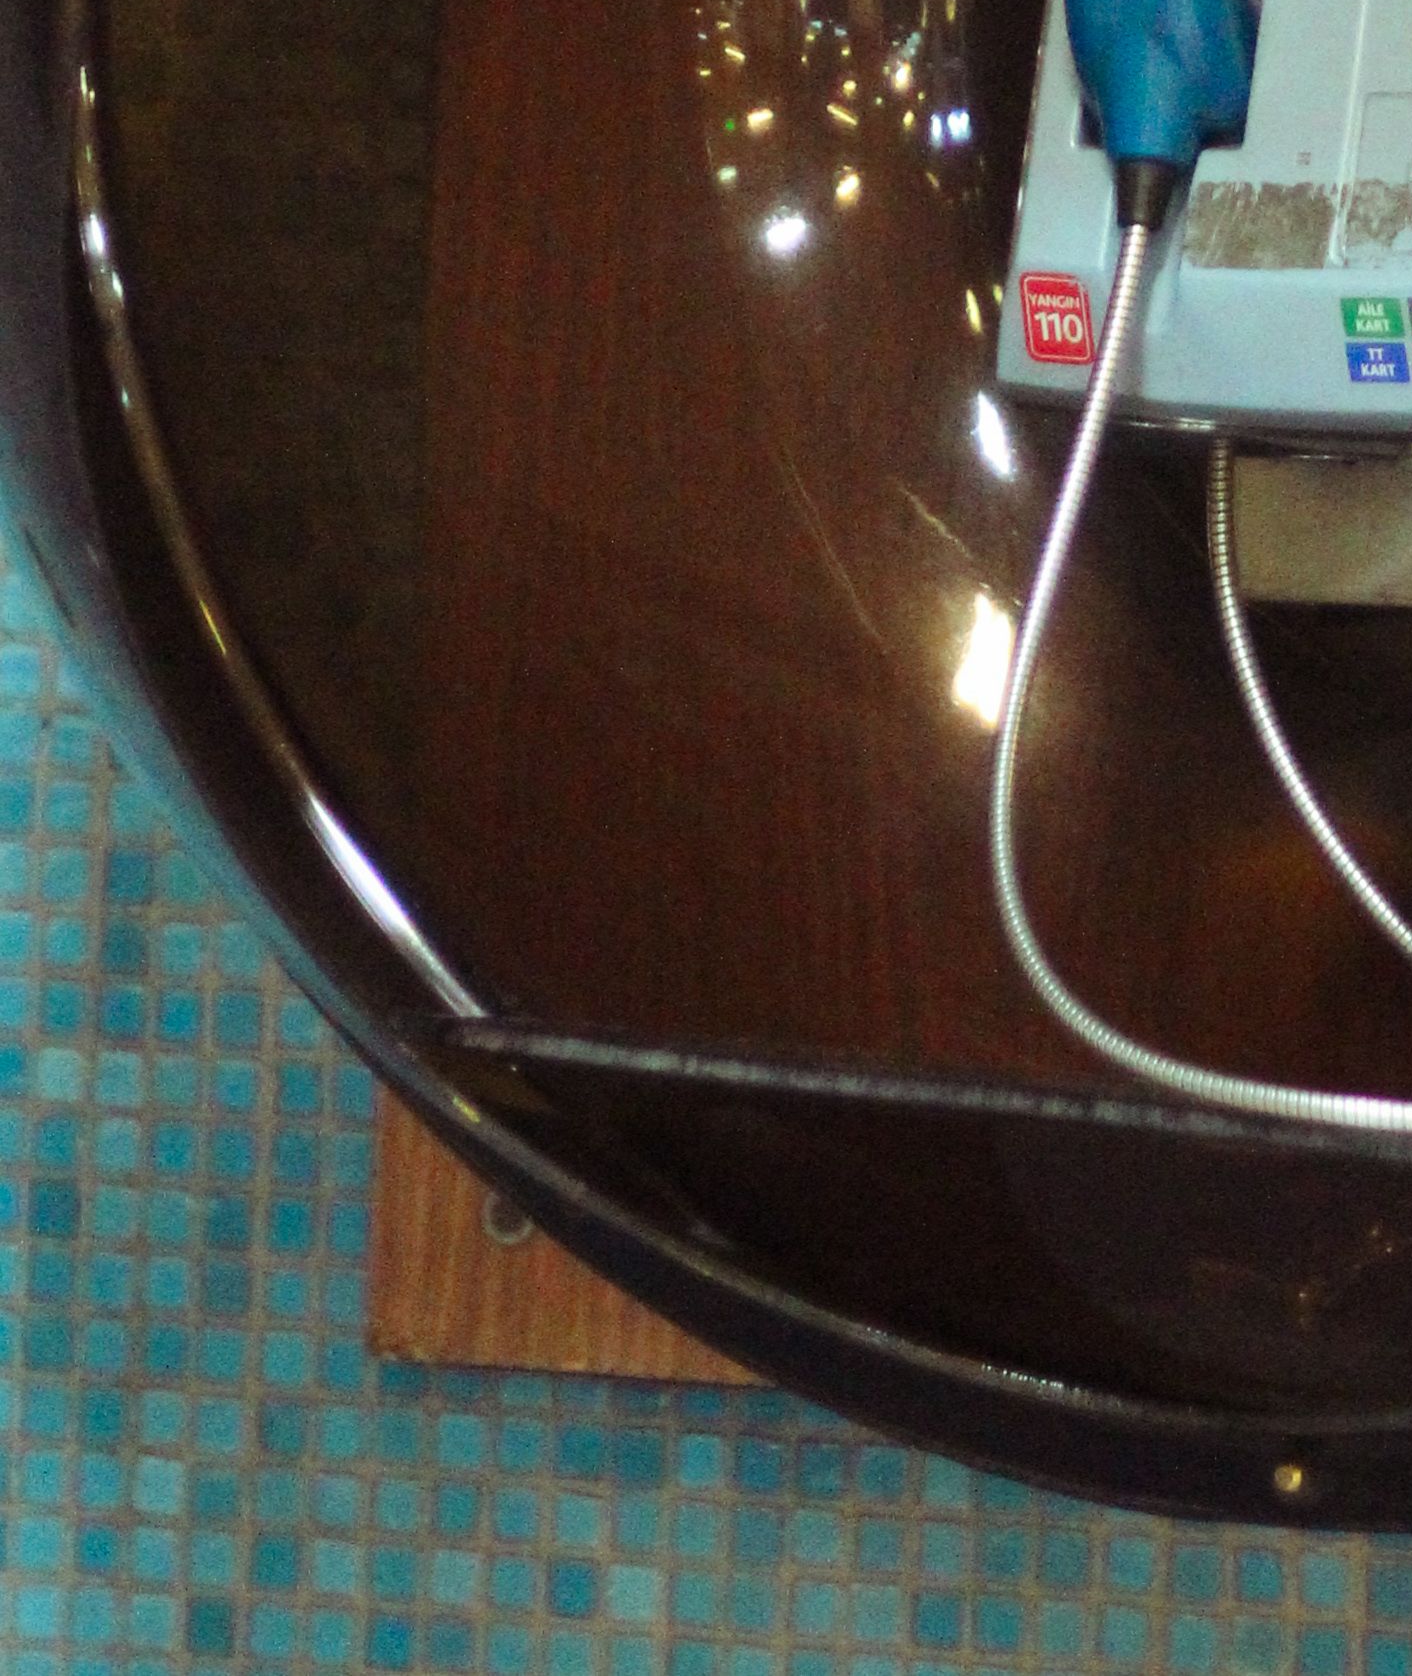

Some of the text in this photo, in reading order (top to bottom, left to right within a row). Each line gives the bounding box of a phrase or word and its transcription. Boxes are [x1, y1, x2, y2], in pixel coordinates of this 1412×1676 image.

[1028, 293, 1081, 309] YANGIN
[1357, 301, 1385, 317] AİLE
[1034, 311, 1084, 345] 110
[1356, 318, 1390, 332] KART
[1367, 347, 1385, 361] TT
[1361, 362, 1396, 377] KART
